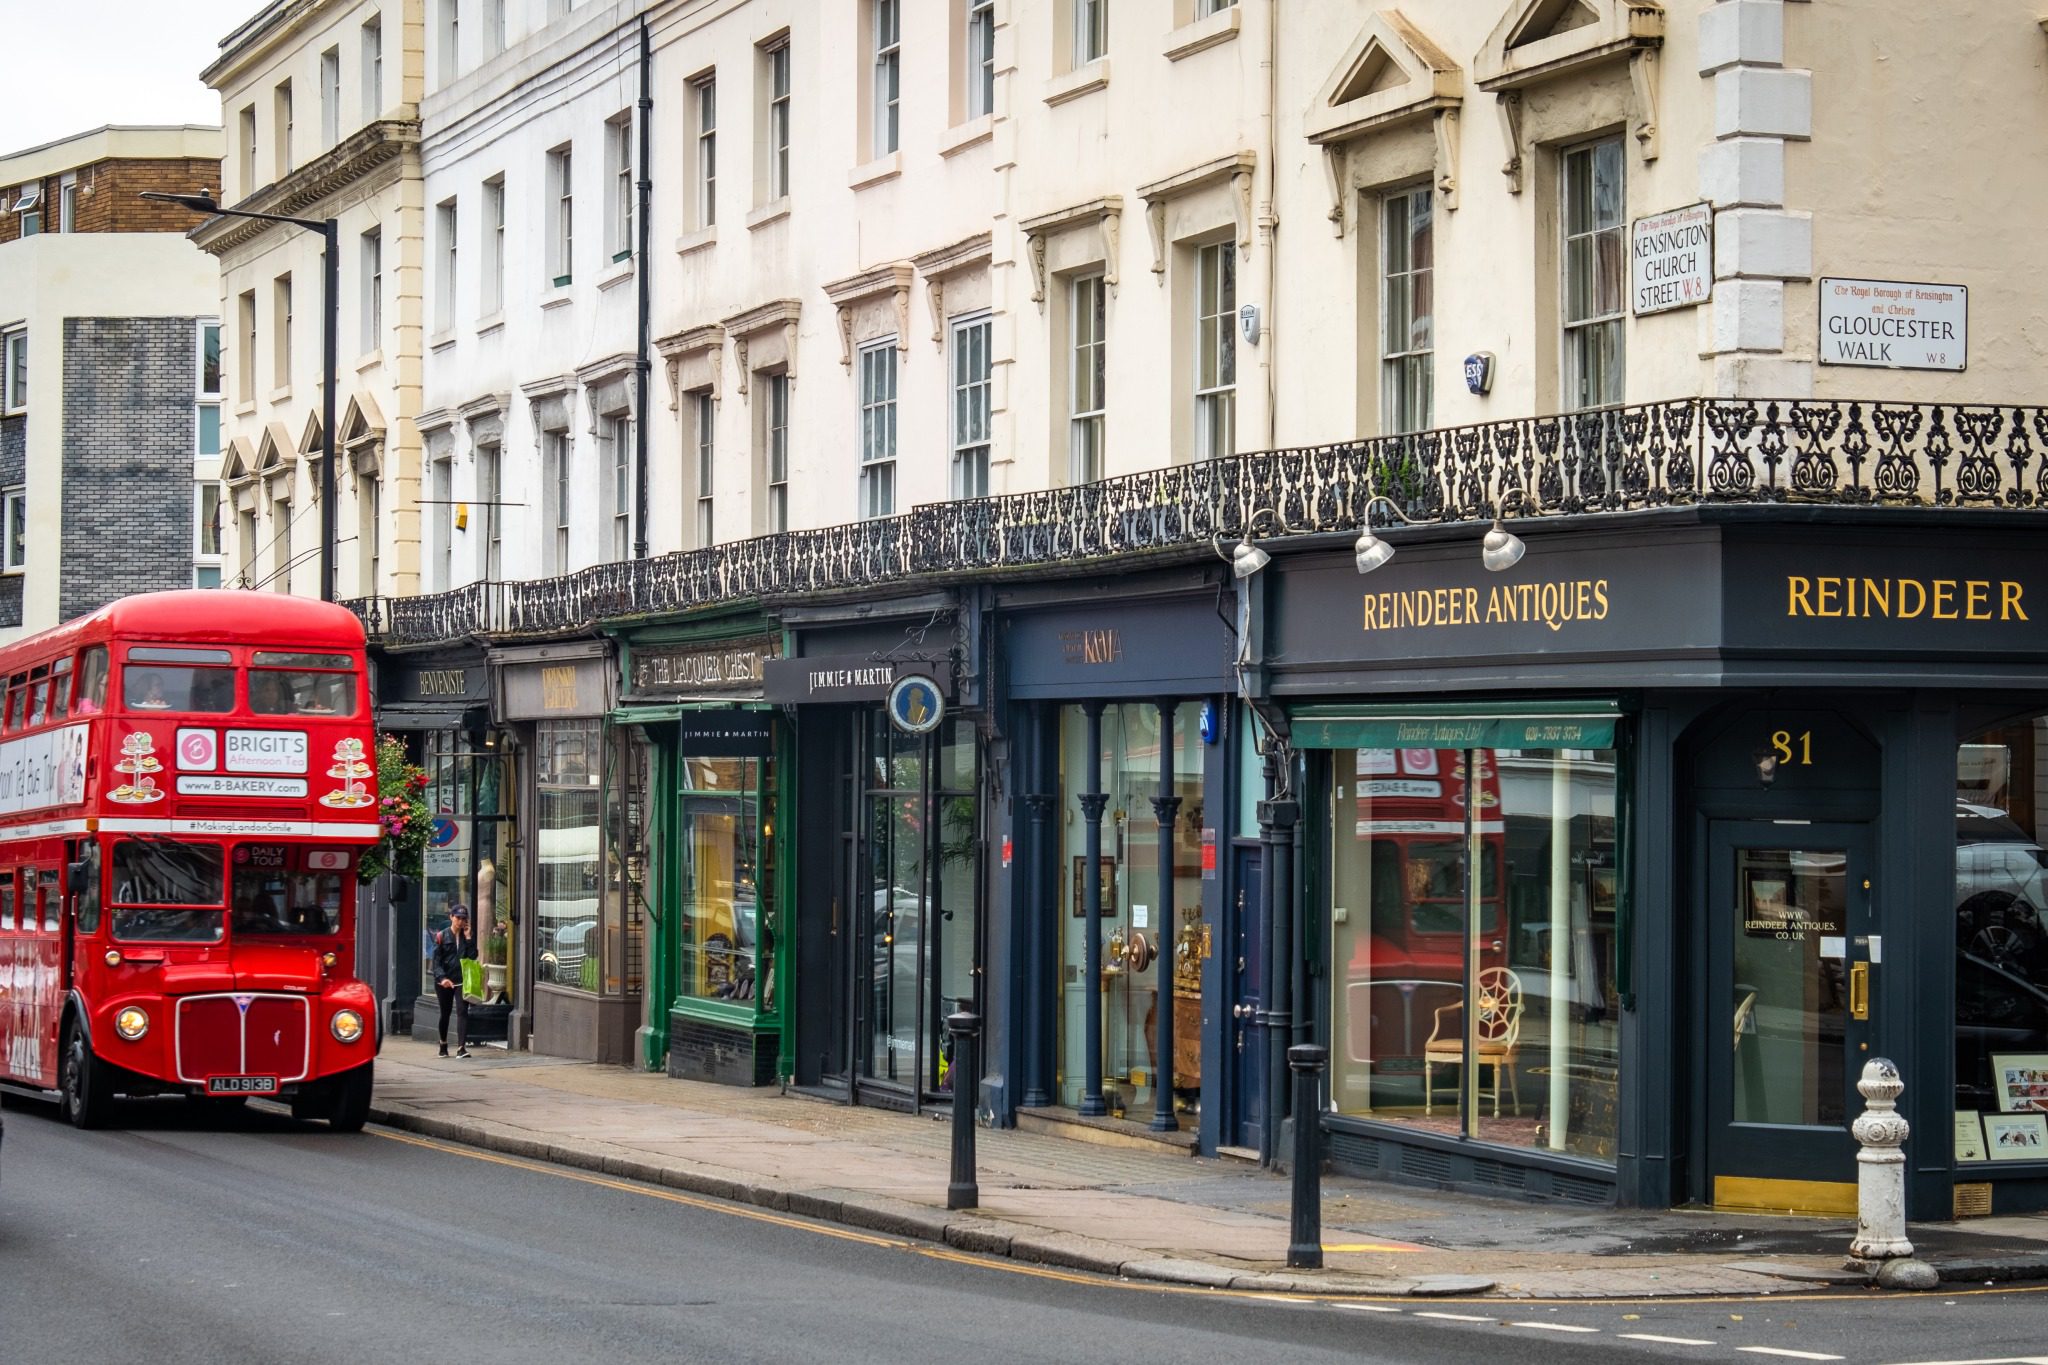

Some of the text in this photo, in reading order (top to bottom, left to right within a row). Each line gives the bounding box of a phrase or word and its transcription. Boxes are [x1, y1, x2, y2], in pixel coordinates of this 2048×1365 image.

[1635, 222, 1708, 259] KENSINGTON
[1645, 251, 1696, 281] CHURCH
[1834, 285, 1953, 303] The Royal Borough of Kensington
[1872, 304, 1916, 316] and Chelsea
[1829, 315, 1955, 340] GLOUCESTER
[1837, 341, 1946, 364] WALK W 8
[1363, 579, 1609, 631] REINDEER ANTIQUES
[1787, 576, 2030, 621] REINDEER
[652, 657, 670, 684] THE
[673, 655, 722, 685] LACQUER
[724, 651, 756, 681] CHEST
[419, 670, 466, 695] BENVENISTE
[809, 669, 846, 695] JIMMIE
[854, 667, 893, 686] MARTIN
[684, 730, 721, 739] JIMMIE
[1397, 722, 1482, 746] Reindeer Antiques Ltd
[228, 736, 304, 753] BRIGIT'S
[1772, 731, 1813, 765] 81
[229, 754, 304, 767] Afternoon Tea
[185, 780, 300, 793] www.B-BAKERY.com
[190, 822, 292, 834] #MakingLondonSmile
[252, 846, 284, 857] DAILY
[252, 856, 284, 866] TOUR
[1745, 920, 1837, 932] REINDEER ANTIQUES.
[1775, 931, 1805, 940] CO.UK
[213, 1079, 273, 1091] ALD 913B
